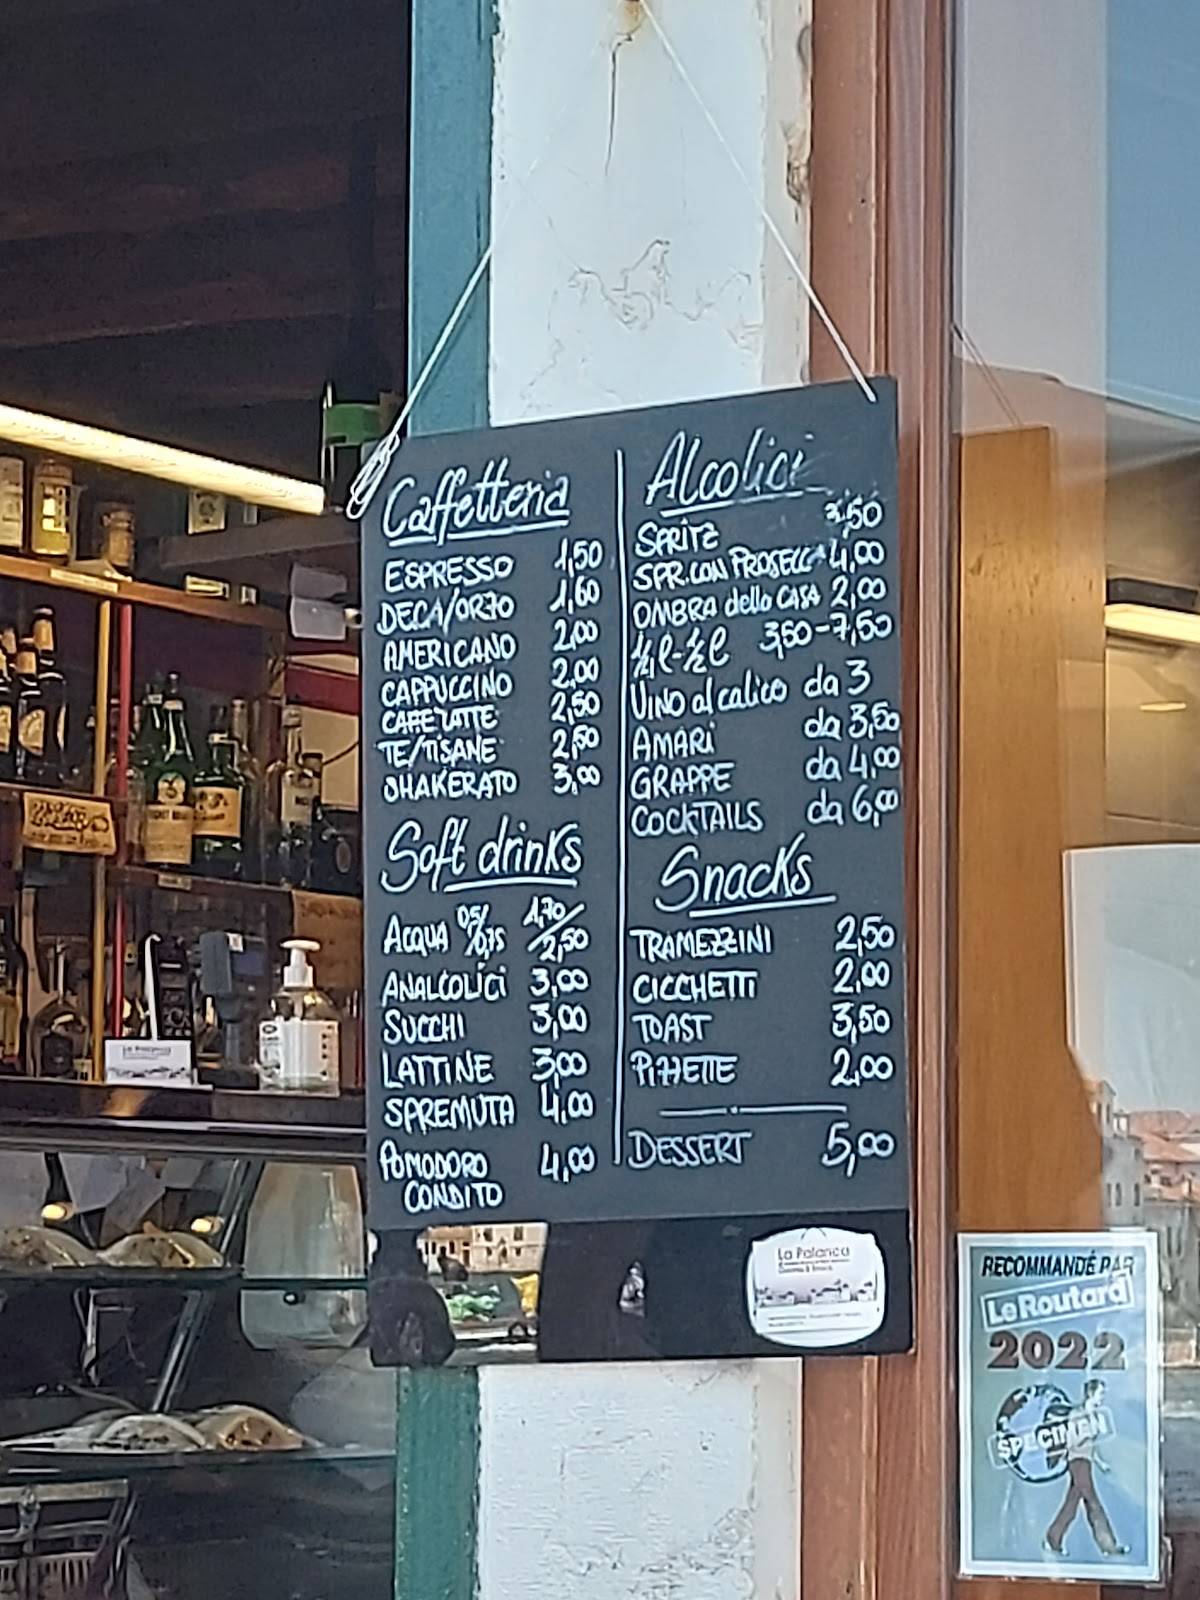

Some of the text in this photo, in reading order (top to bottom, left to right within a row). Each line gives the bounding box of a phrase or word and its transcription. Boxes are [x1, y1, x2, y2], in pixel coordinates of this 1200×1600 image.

[383, 458, 570, 546] Caffetteria
[386, 538, 602, 592] ESPRESSO 1,50
[830, 539, 885, 574] 4,00
[377, 576, 600, 634] DECA/ORZO 1,60
[633, 598, 717, 630] OMBRA
[776, 583, 821, 611] CASA
[831, 577, 887, 609] 2,00
[384, 619, 598, 671] AMERICANO 2,00
[381, 657, 599, 707] CAPPUCCINO 2,00
[692, 676, 714, 715] al
[803, 664, 839, 697] da
[847, 660, 871, 695] 3
[551, 691, 600, 725] 2,50
[805, 708, 841, 739] da
[849, 701, 900, 740] 3,50
[553, 725, 599, 759] 2,50
[384, 763, 600, 802] SHAKERATO 3,00
[630, 745, 900, 799] GRAPPE da 4,00
[631, 786, 899, 838] COCKTAILS da 6,00
[380, 815, 582, 892] Soft drinks
[655, 833, 813, 912] Snacks
[629, 915, 895, 963] TRAMEZZINI 2,50
[529, 969, 589, 998] 3,00
[632, 957, 890, 1004] CICCHETTI 2,00
[383, 1004, 588, 1045] SUCCHI 3,00
[632, 1002, 891, 1044] TOAST 3,50
[380, 1048, 588, 1089] LATTINE 3,00
[830, 1047, 893, 1087] 2,00
[384, 1083, 594, 1134] SPREMUTA 4,00
[379, 1139, 595, 1183] POMODORO 4,00
[628, 1121, 895, 1177] DESSERT 5,00
[404, 1180, 503, 1214] CONDITO
[777, 1246, 851, 1261] La Palanca
[981, 1250, 1135, 1278] RECOMMANDÉ PAR
[986, 1330, 1127, 1371] 2022
